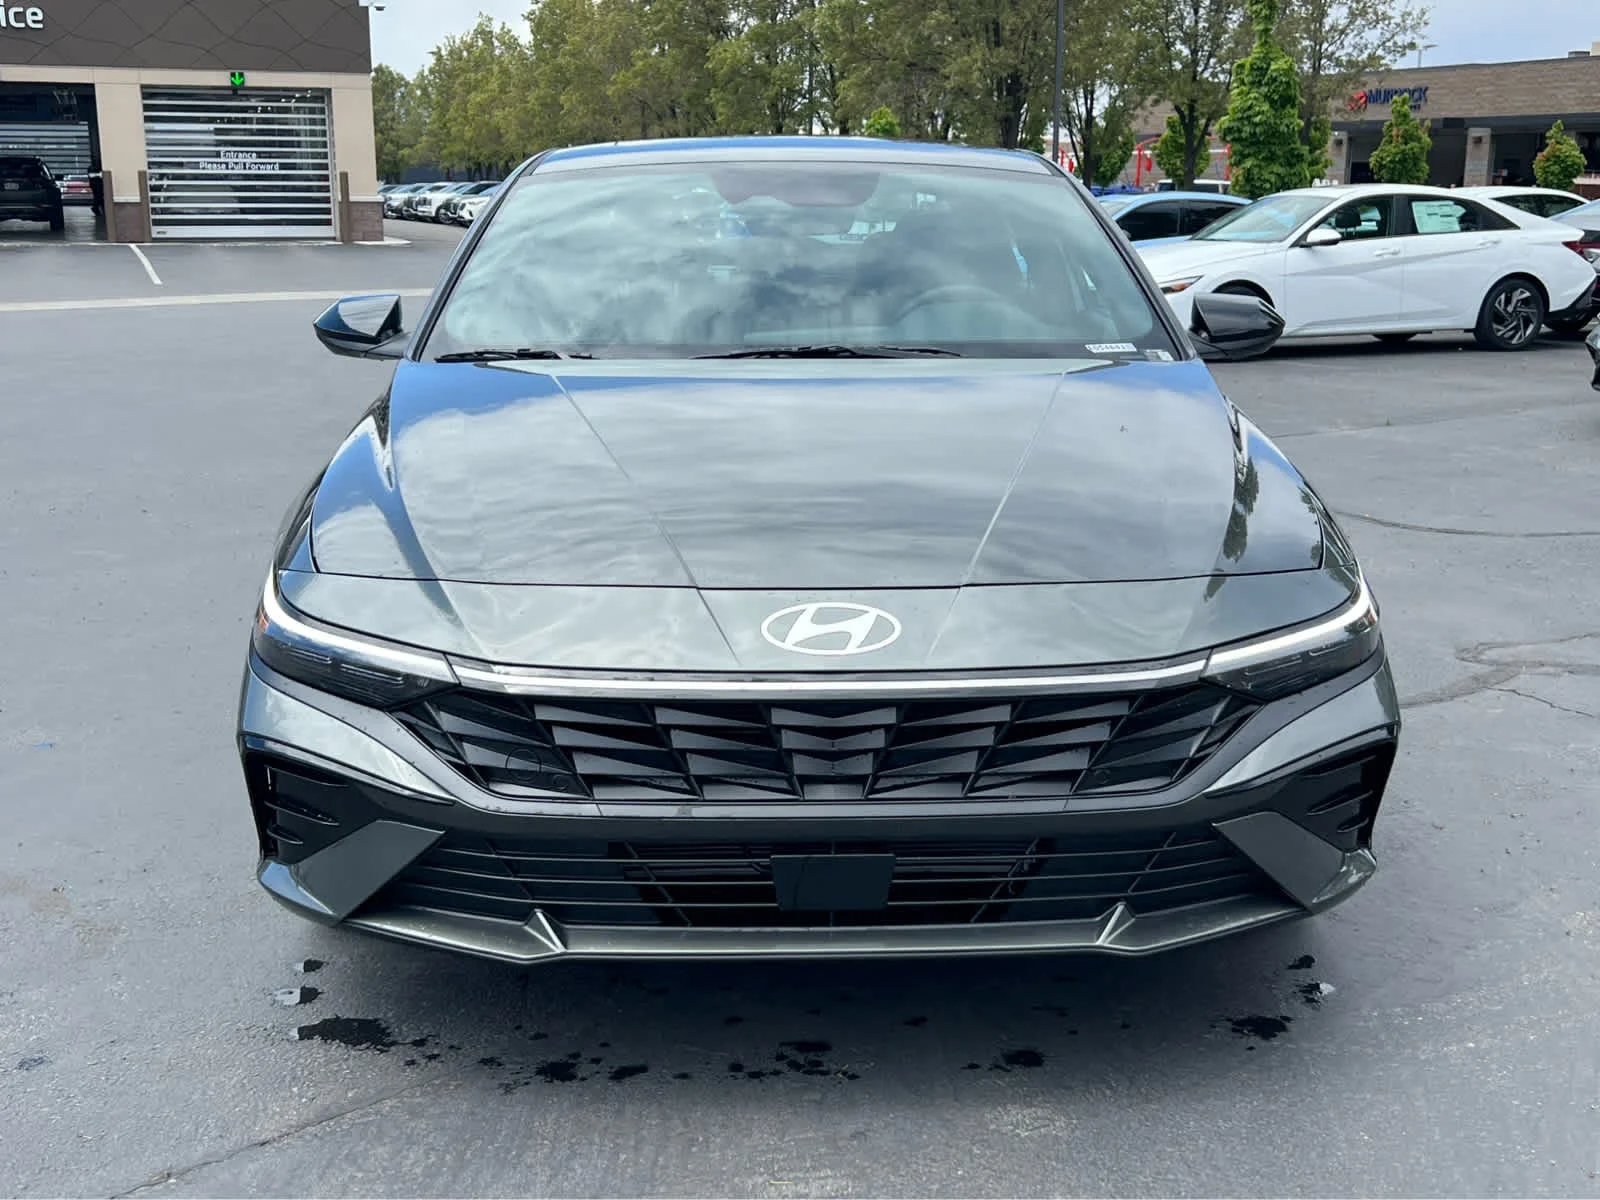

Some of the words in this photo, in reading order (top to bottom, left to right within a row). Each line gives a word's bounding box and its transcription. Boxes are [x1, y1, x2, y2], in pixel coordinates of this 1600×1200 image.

[220, 150, 256, 160] Entrance
[199, 161, 226, 170] Please
[228, 161, 244, 170] Pull
[246, 161, 279, 170] Forward
